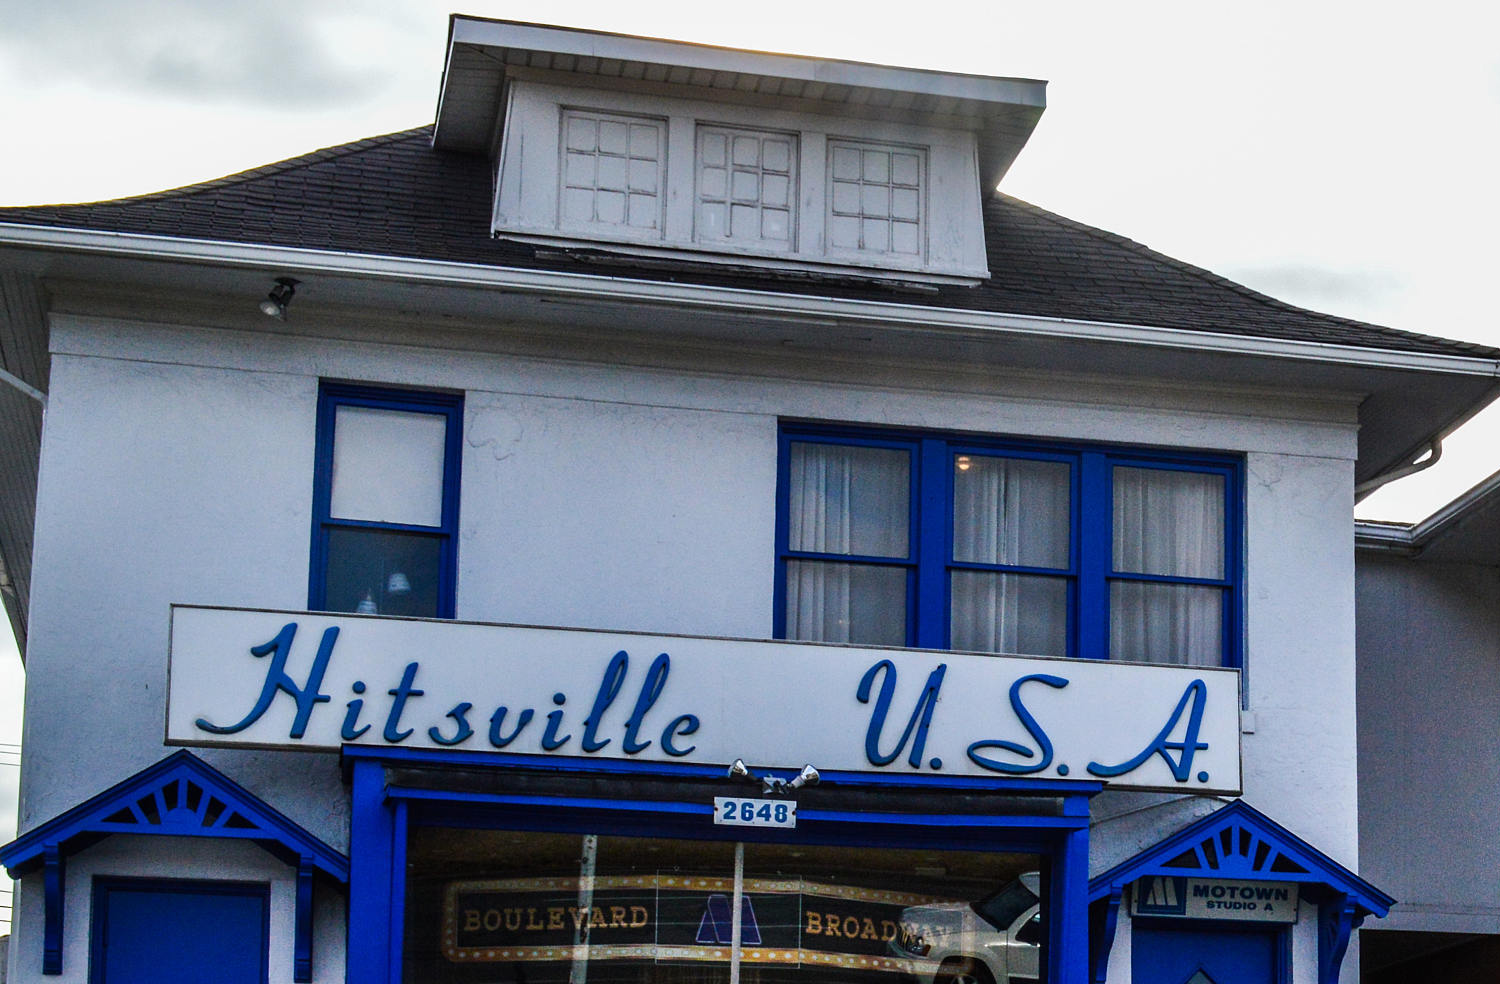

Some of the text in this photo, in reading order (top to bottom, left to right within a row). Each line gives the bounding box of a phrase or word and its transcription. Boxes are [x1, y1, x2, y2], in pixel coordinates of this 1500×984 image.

[195, 622, 700, 757] Hitsville
[722, 801, 788, 823] 2648
[1193, 884, 1289, 901] MOTOWN
[1206, 900, 1273, 911] STUDIO A
[463, 906, 648, 931] BOULEVARD
